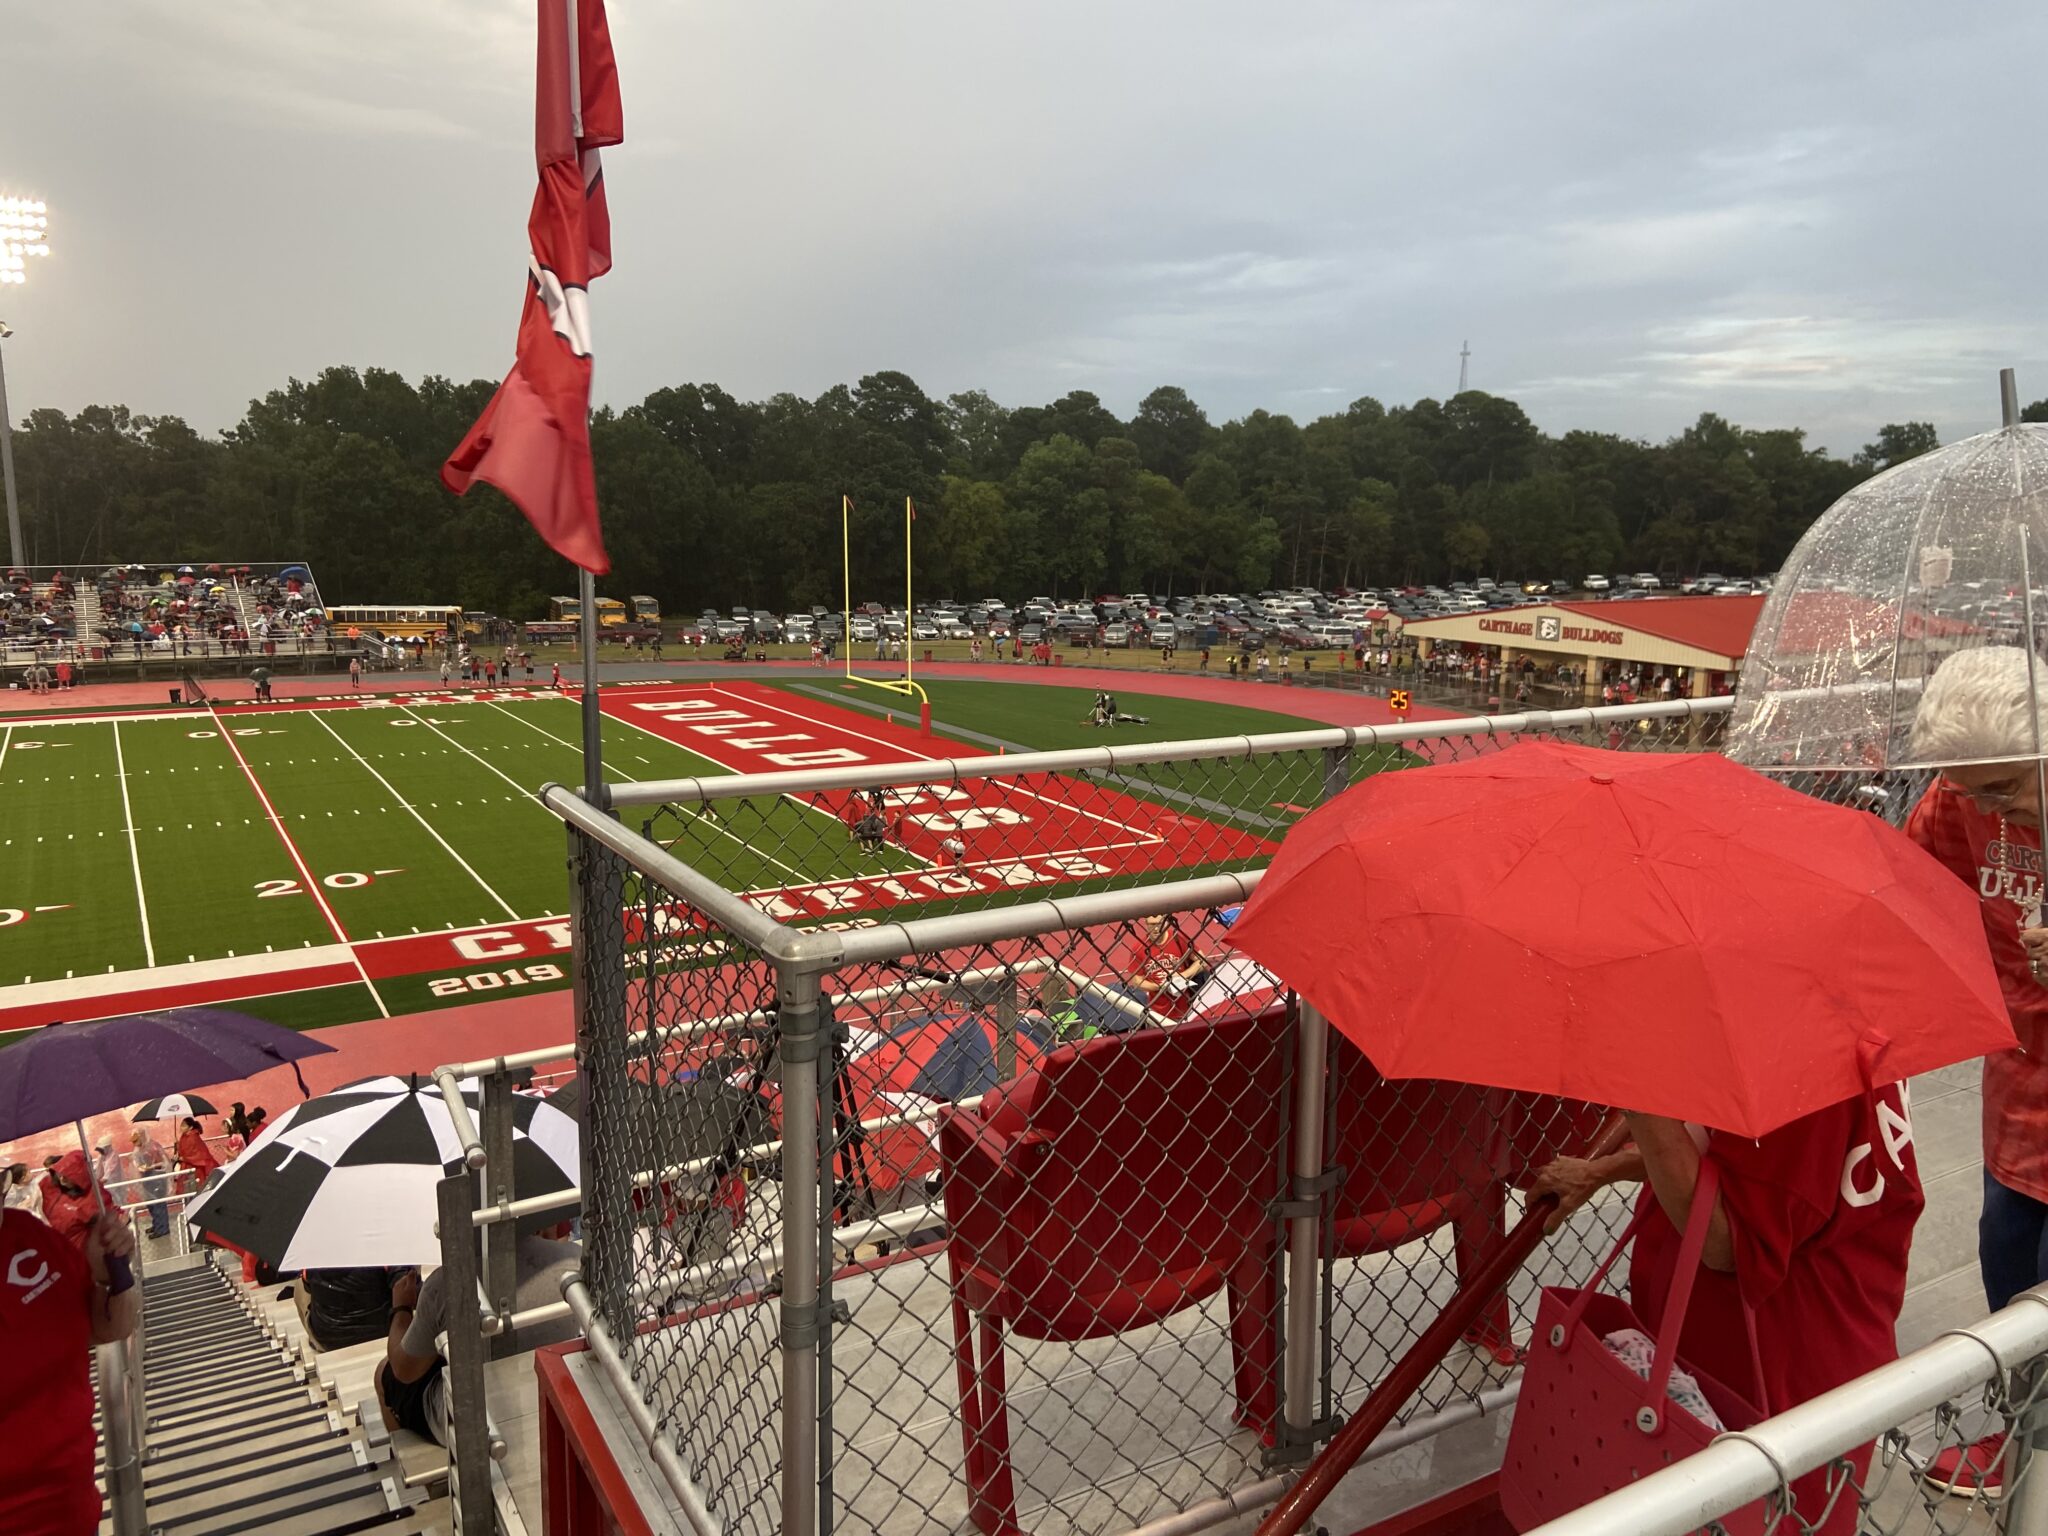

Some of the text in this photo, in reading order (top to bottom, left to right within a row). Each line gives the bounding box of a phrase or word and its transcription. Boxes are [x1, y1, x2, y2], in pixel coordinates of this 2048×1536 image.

[1479, 619, 1624, 645] CARTHAGE BULLDOGS
[1391, 690, 1408, 709] 25
[629, 700, 1034, 832] BULLDGS
[254, 872, 370, 898] 20
[428, 964, 563, 997] 2019
